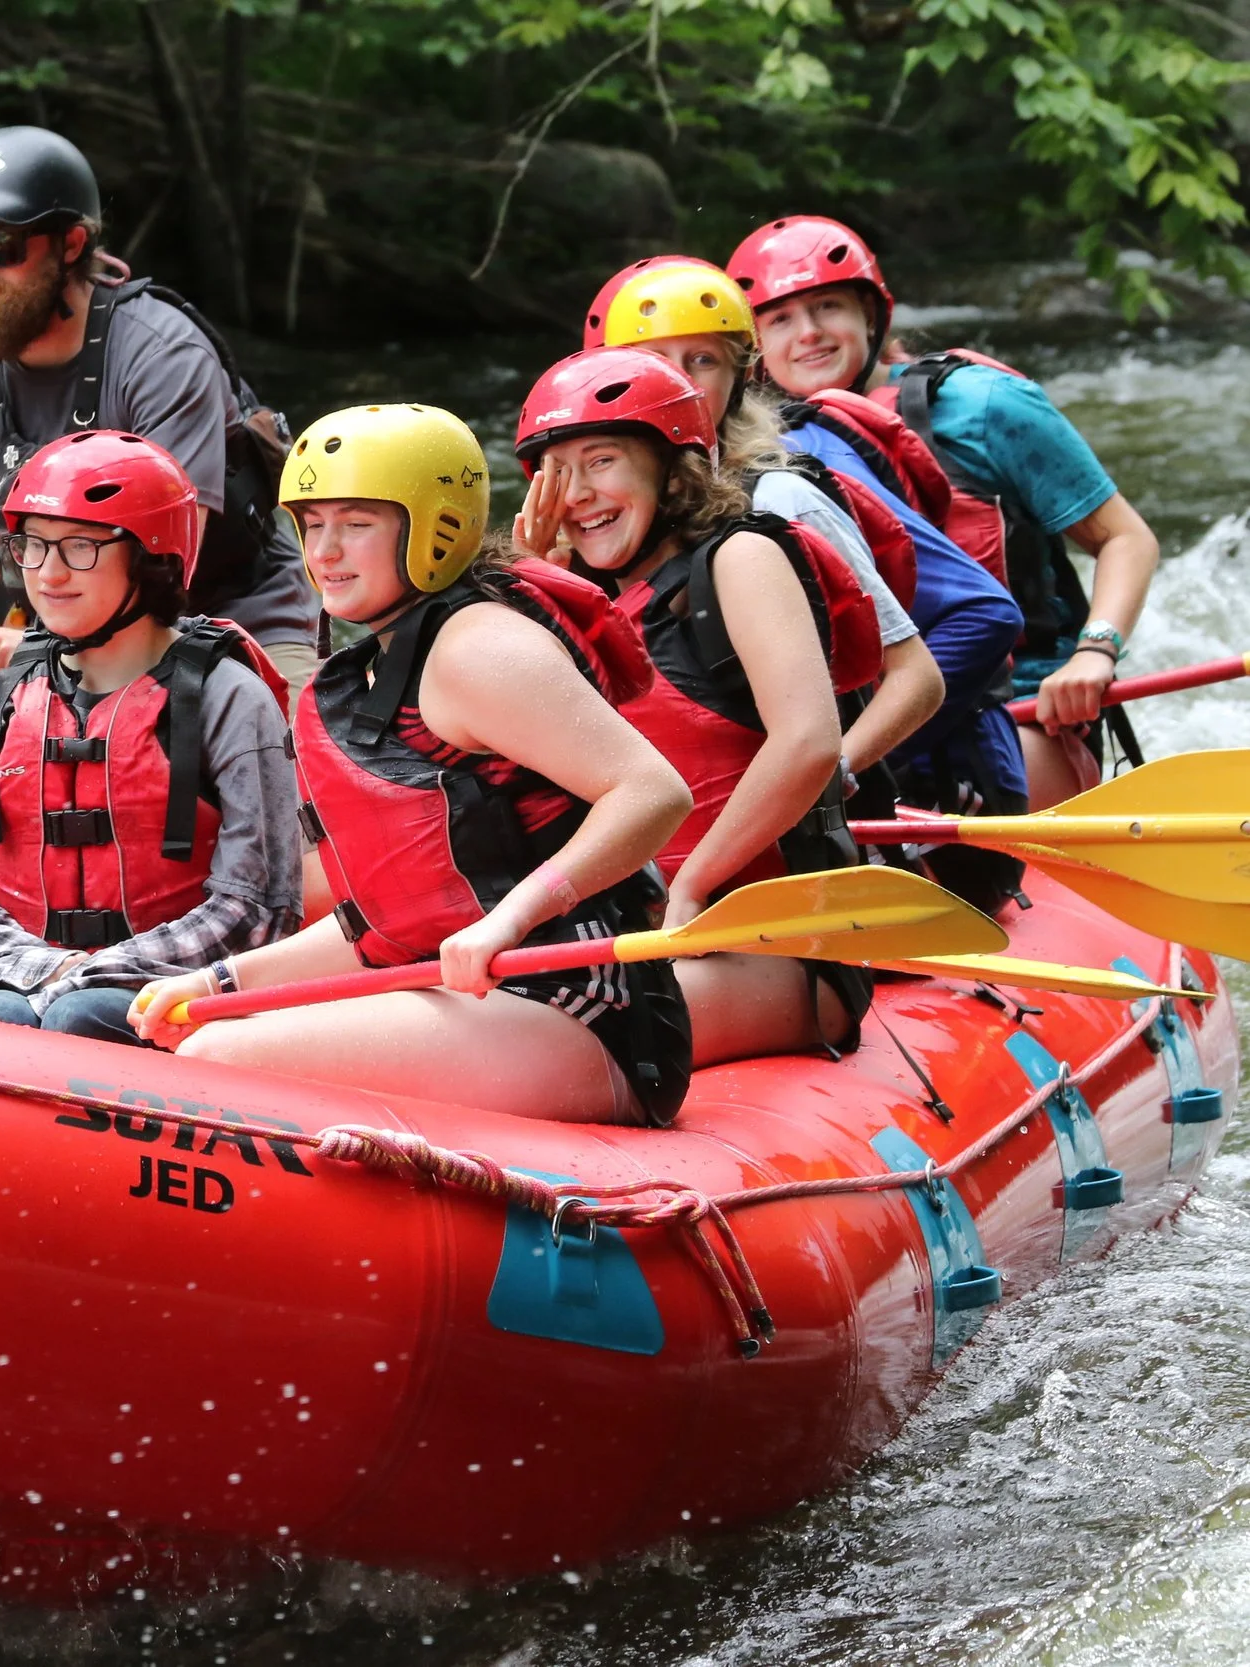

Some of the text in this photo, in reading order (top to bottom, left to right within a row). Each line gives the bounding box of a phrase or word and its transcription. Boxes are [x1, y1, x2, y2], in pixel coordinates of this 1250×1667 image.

[774, 270, 815, 289] NRS
[535, 408, 573, 425] NRS
[23, 494, 60, 506] NRS
[129, 1155, 235, 1214] JED
